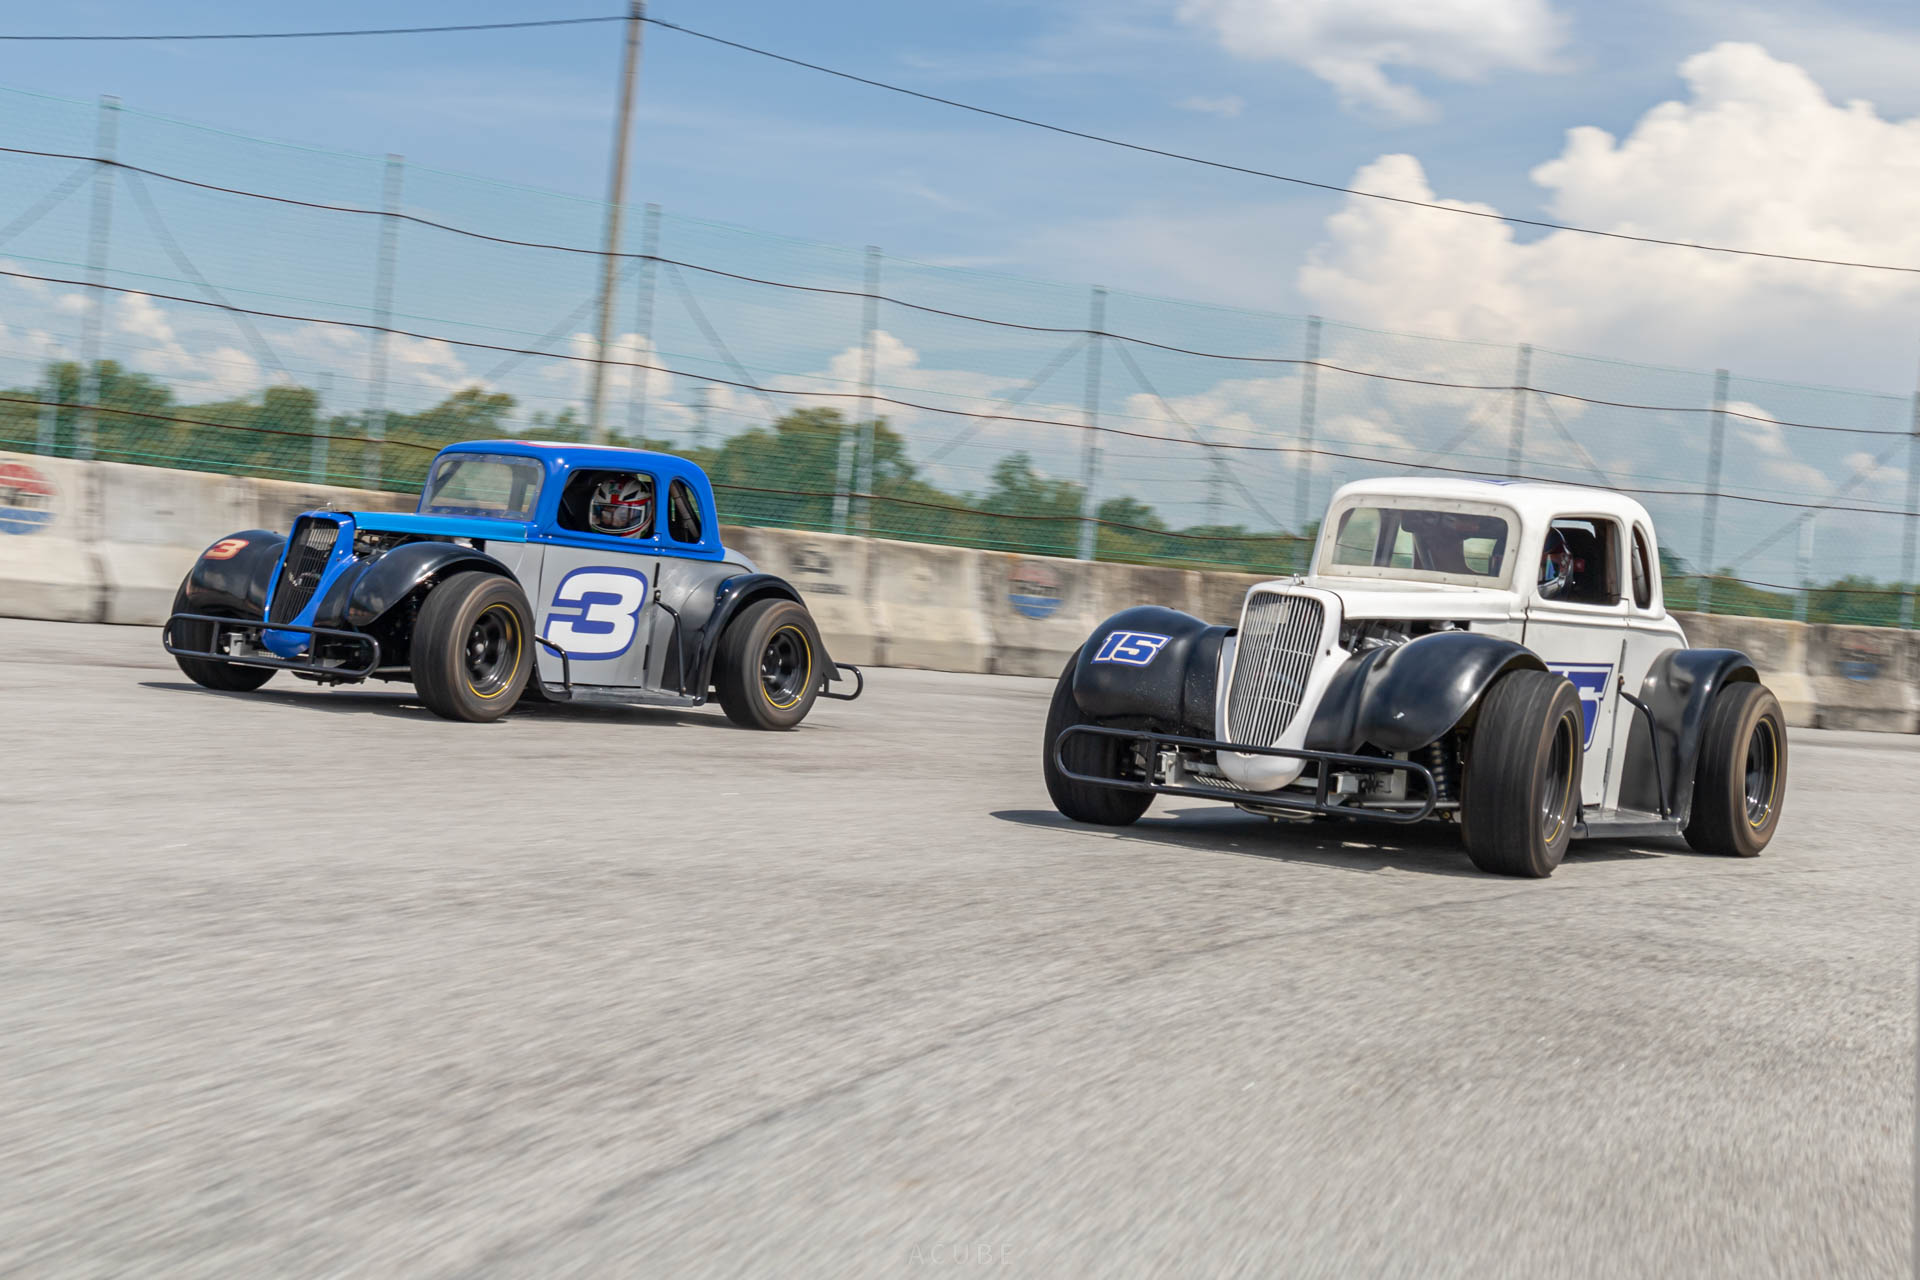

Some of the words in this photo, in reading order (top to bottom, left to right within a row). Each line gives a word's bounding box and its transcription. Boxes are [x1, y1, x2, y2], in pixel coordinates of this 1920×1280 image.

[201, 538, 250, 560] 3
[543, 566, 648, 661] 3
[1090, 630, 1173, 668] 15
